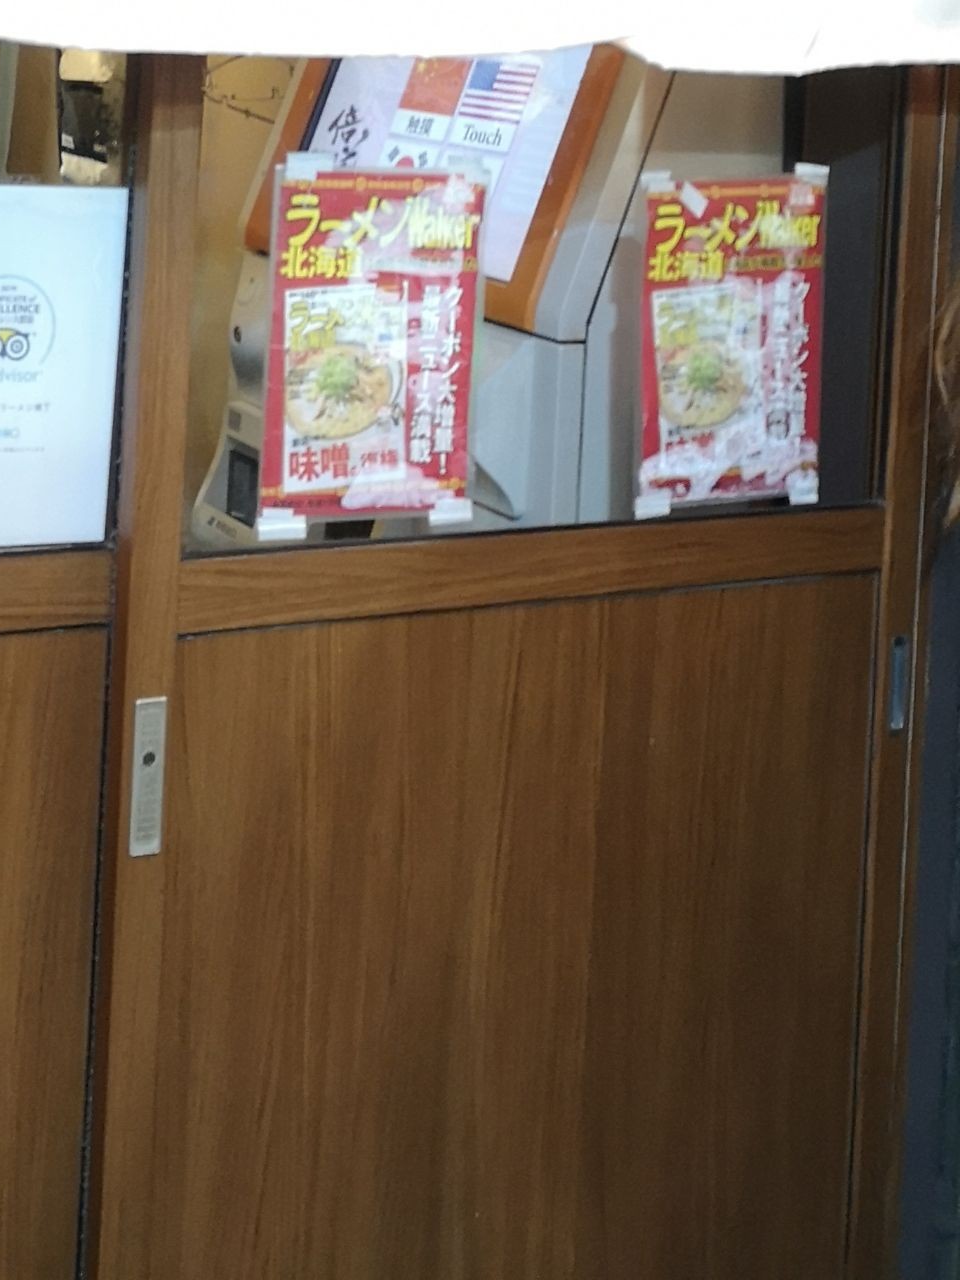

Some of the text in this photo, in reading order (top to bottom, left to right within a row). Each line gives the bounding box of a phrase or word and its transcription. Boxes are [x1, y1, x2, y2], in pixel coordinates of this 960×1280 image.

[462, 123, 503, 147] Touch
[280, 245, 363, 279] 北海道
